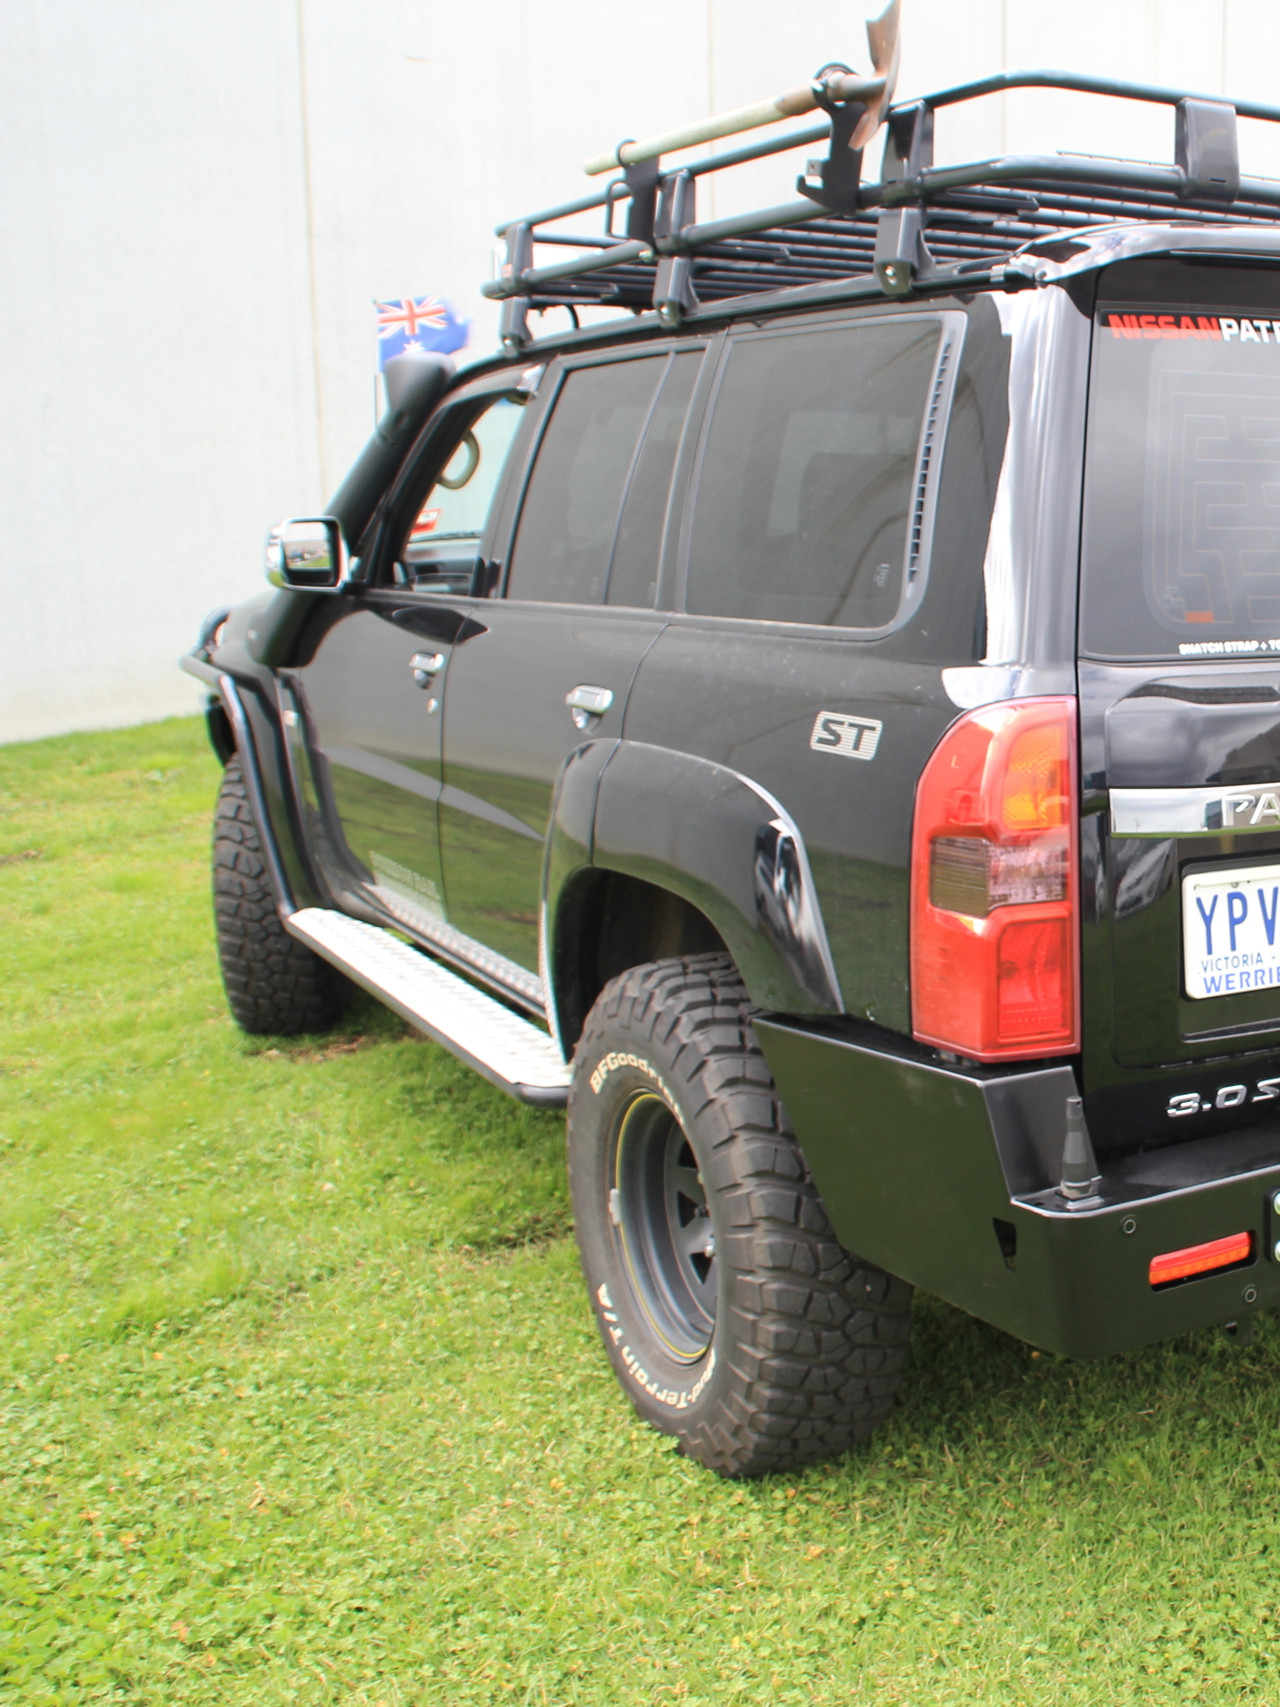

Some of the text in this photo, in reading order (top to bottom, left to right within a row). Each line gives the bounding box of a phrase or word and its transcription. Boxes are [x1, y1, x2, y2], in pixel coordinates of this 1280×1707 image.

[1223, 640, 1259, 653] STRAP
[815, 717, 878, 752] ST
[1195, 886, 1280, 956] YPV
[1200, 952, 1264, 973] VICTORIA
